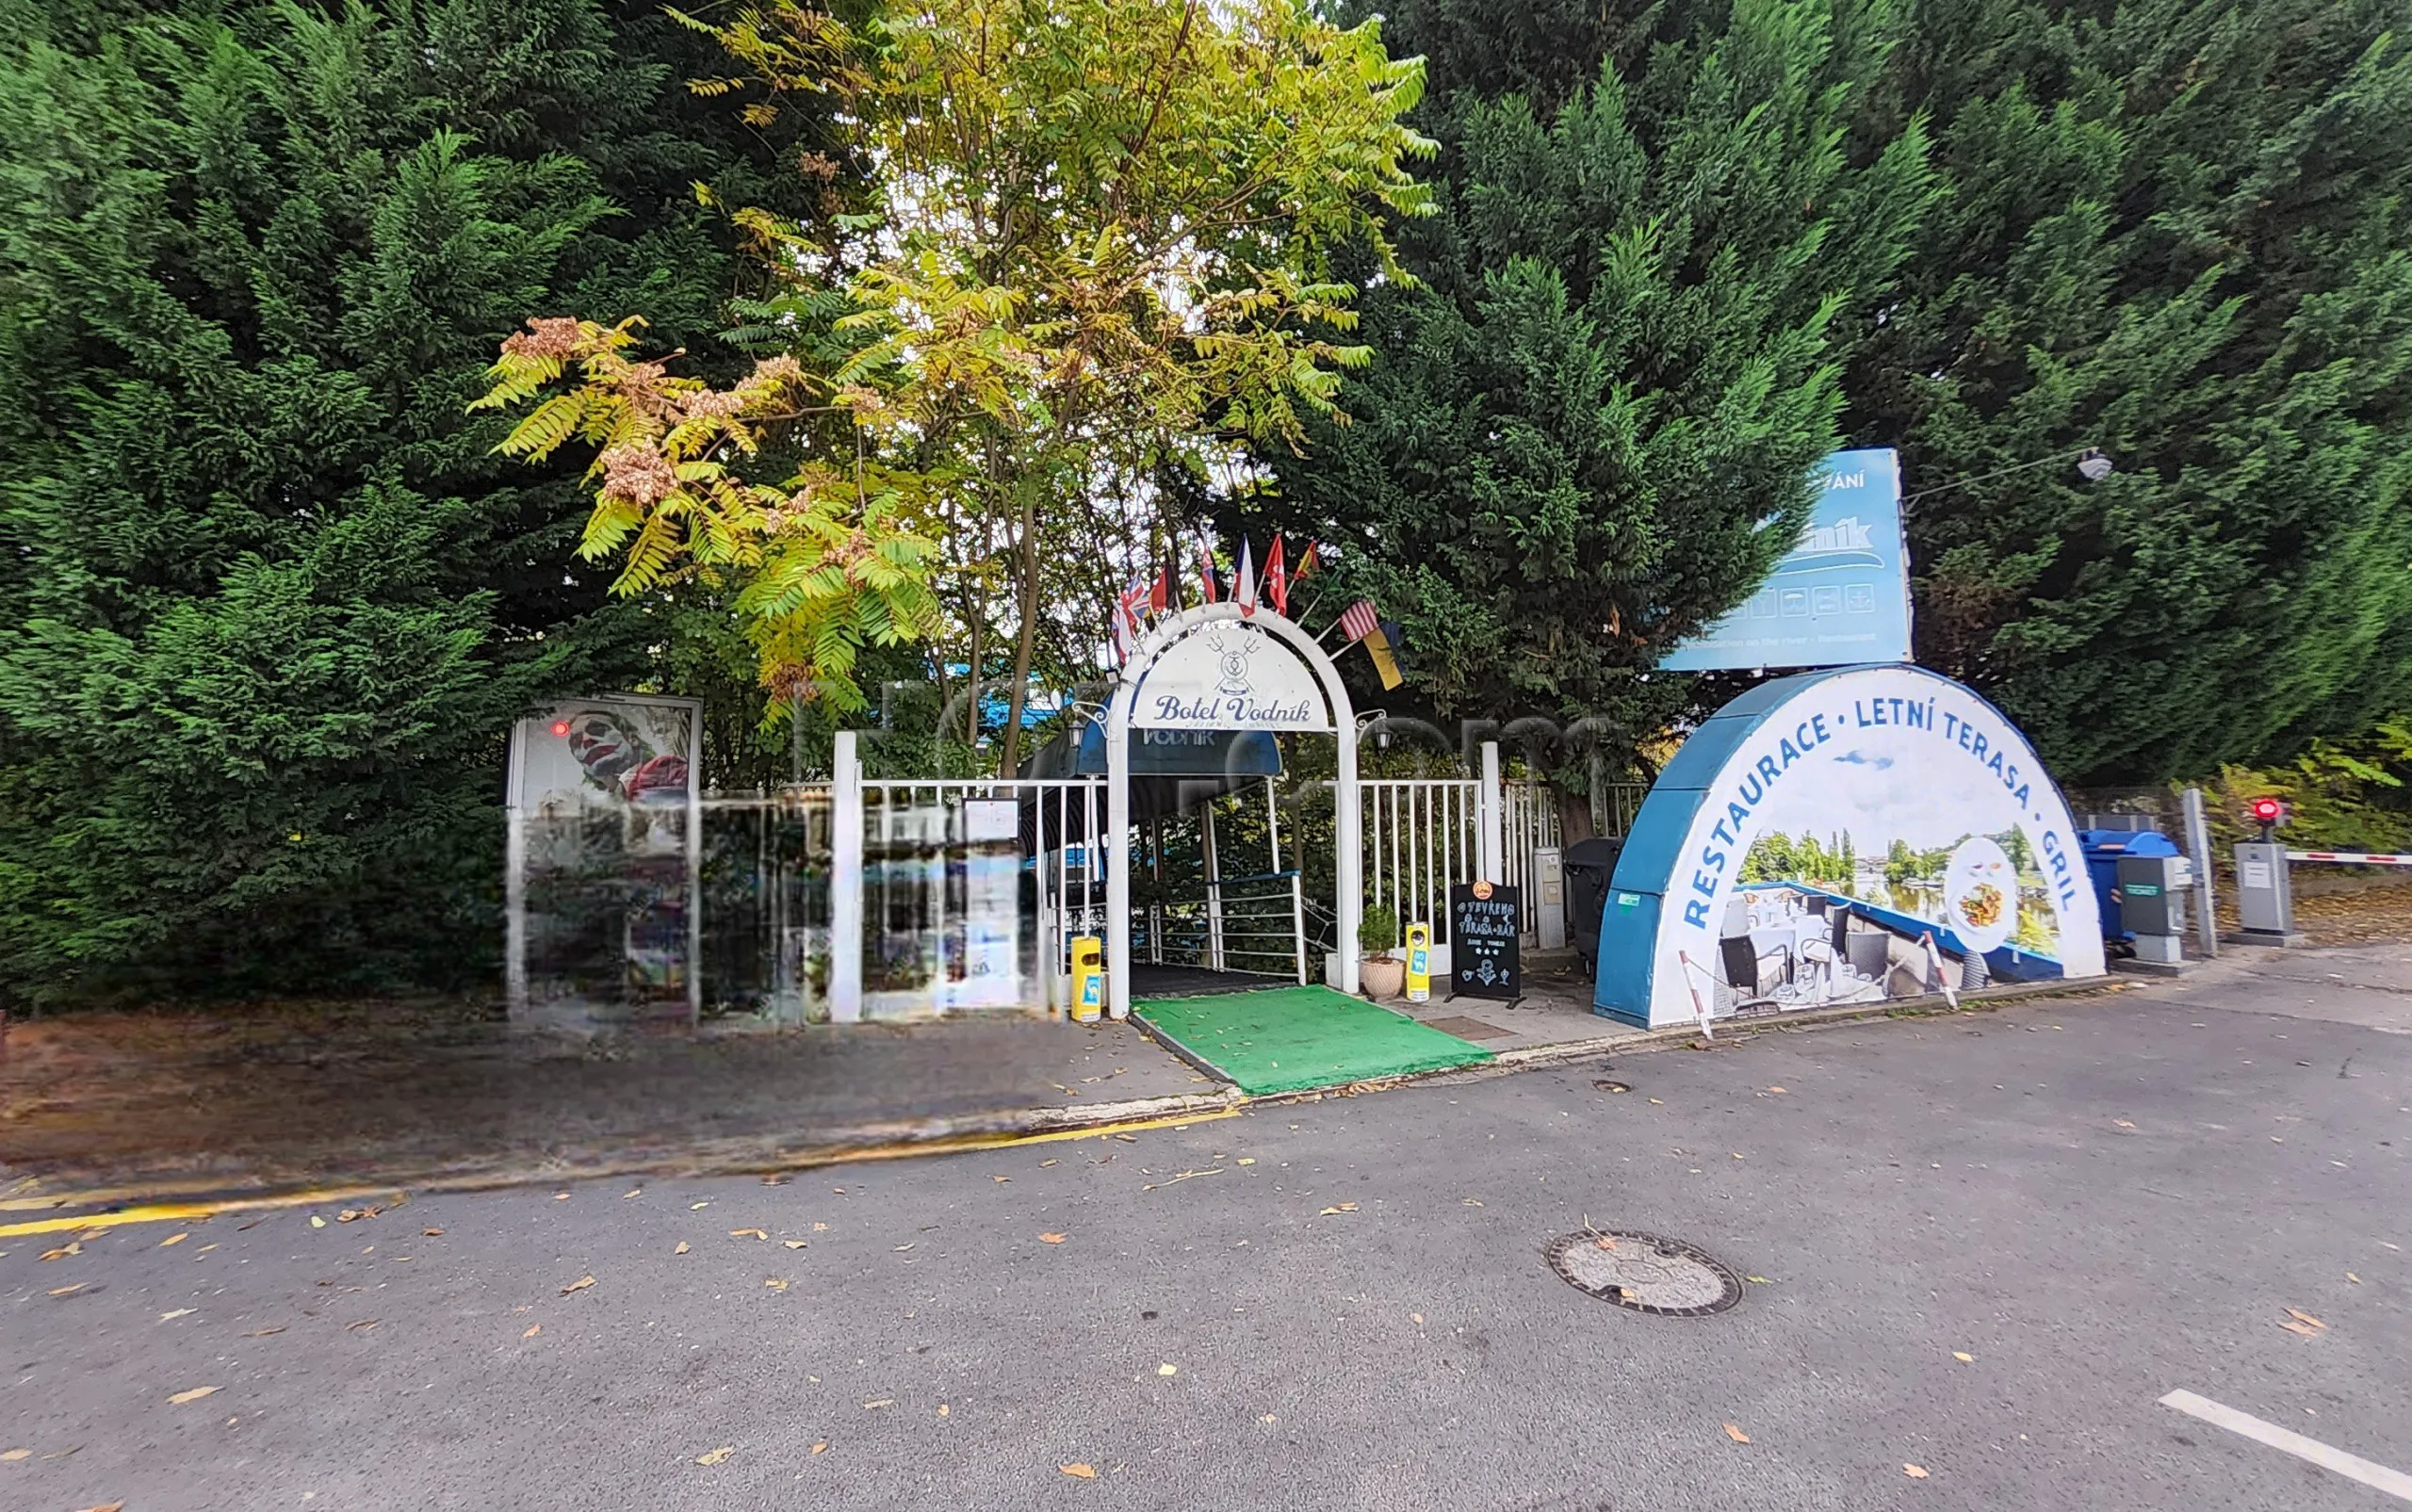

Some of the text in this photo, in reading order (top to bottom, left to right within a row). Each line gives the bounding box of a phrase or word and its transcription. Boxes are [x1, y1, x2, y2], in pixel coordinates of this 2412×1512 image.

[1154, 695, 1312, 722] Botel Vodník
[1684, 697, 2078, 930] RESTAURACE LETNÍ TERASA GRIL
